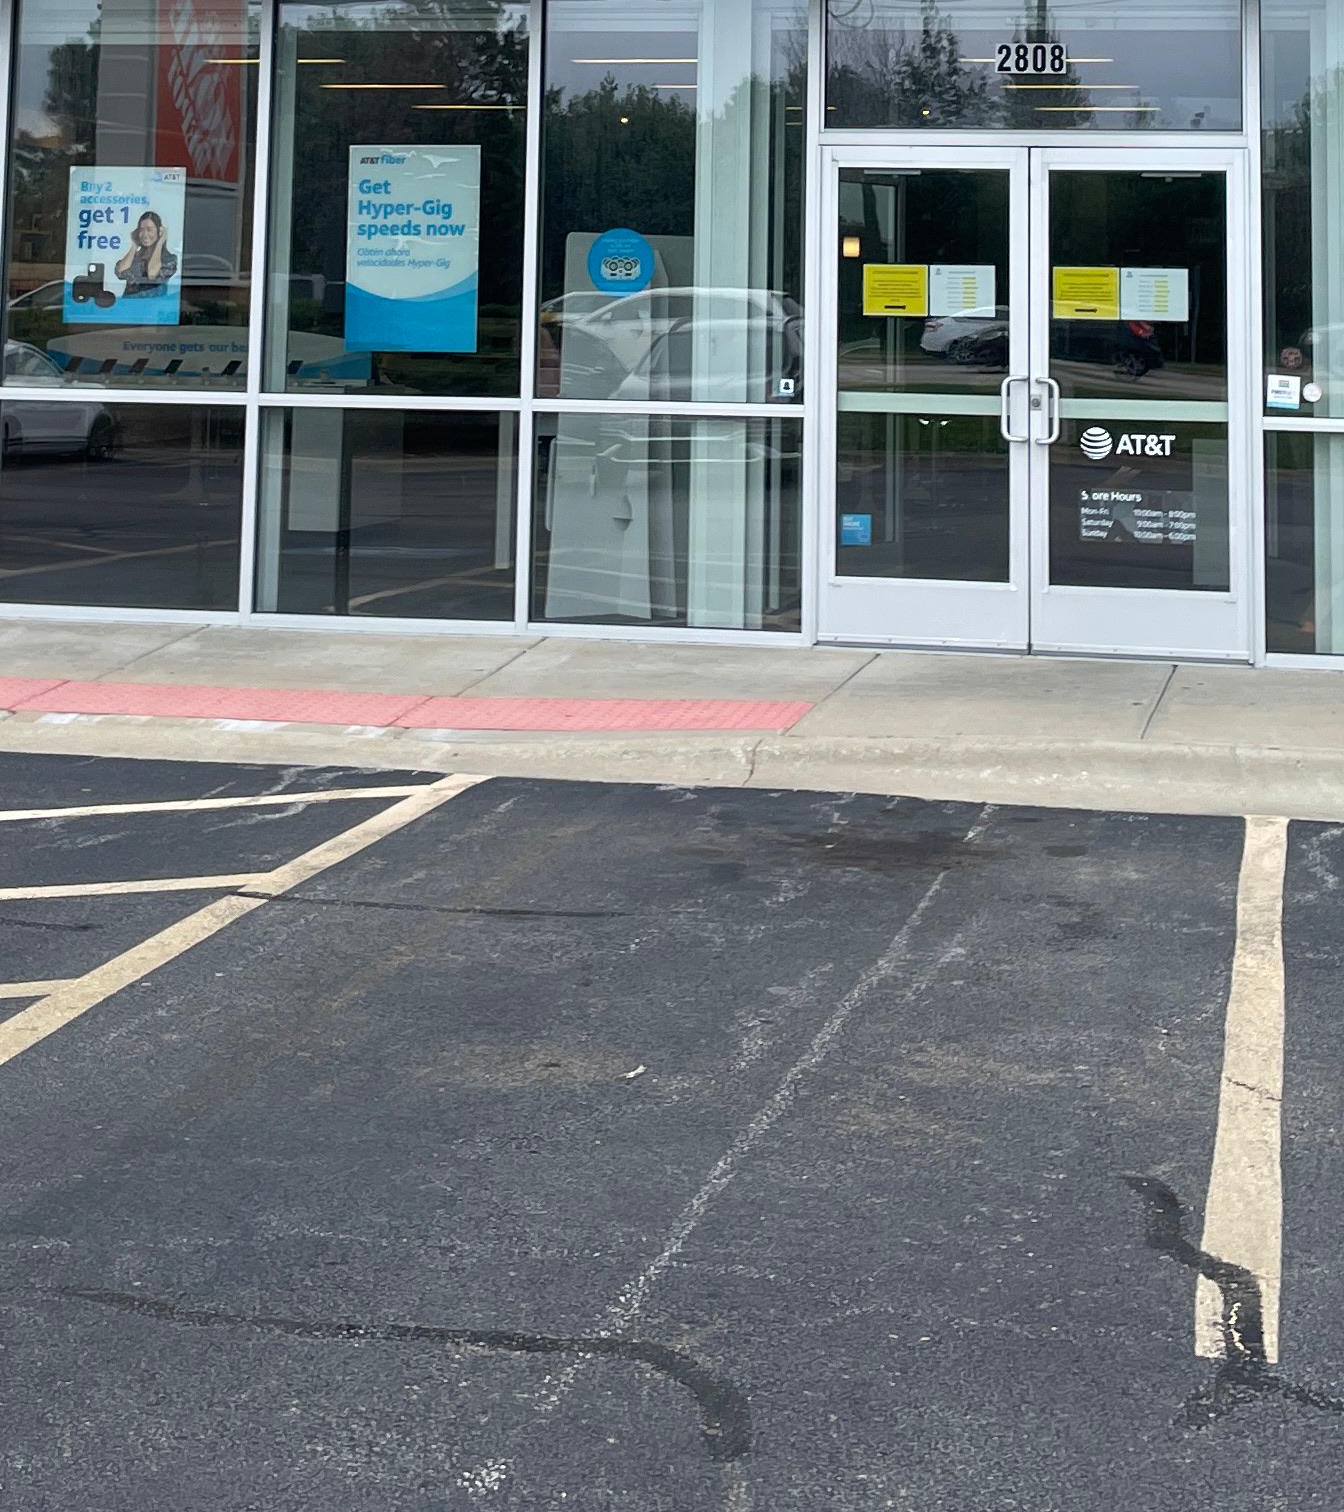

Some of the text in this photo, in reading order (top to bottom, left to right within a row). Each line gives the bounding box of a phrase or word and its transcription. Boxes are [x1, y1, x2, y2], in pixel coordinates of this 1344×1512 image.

[997, 44, 1064, 73] 2808
[360, 154, 407, 165] AT&T fiber
[163, 173, 181, 181] AT&T
[80, 181, 113, 194] Buy 2
[358, 178, 392, 195] Get
[79, 193, 151, 206] accessories,
[357, 199, 453, 220] Hyper-Gig
[78, 206, 129, 229] get 1
[357, 219, 466, 241] speeds now
[77, 230, 121, 249] free
[122, 341, 176, 354] Everyone
[179, 342, 205, 354] gets
[208, 343, 228, 353] our
[1115, 433, 1176, 456] AT&T
[1110, 491, 1142, 503] Hours
[1080, 517, 1114, 528] Saturday
[1080, 528, 1108, 539] Sunday
